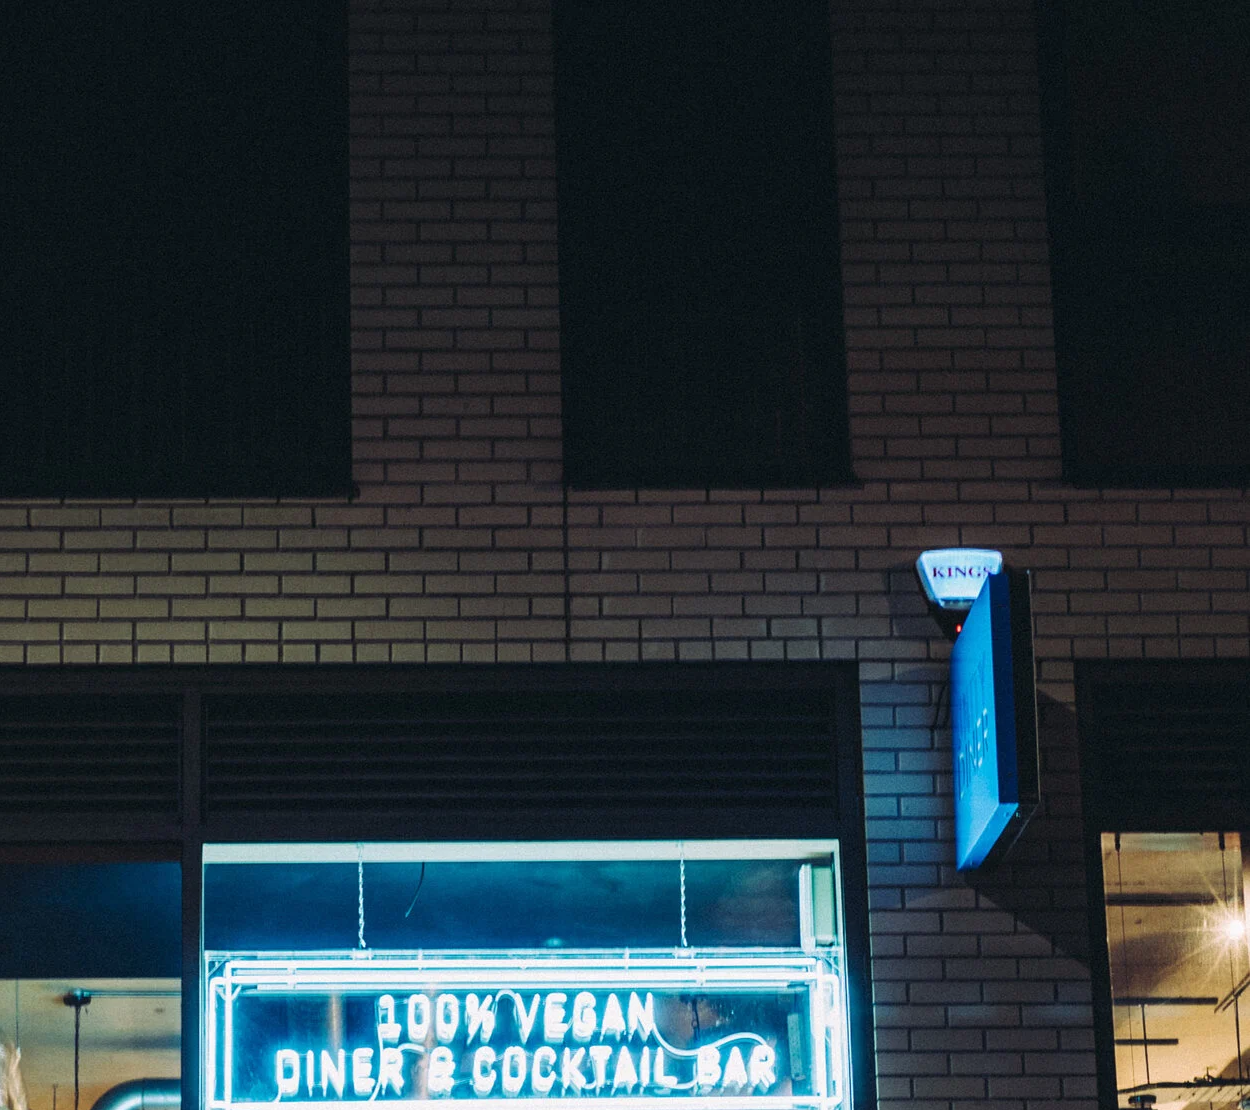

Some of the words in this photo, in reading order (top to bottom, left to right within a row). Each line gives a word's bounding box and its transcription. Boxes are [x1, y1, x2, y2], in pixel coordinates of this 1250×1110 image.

[378, 994, 496, 1042] 100%
[514, 991, 654, 1042] VEGAN
[276, 1048, 404, 1097] DINER
[427, 1046, 456, 1095] &
[473, 1045, 678, 1095] COCKTAIL
[696, 1044, 777, 1094] BAR
